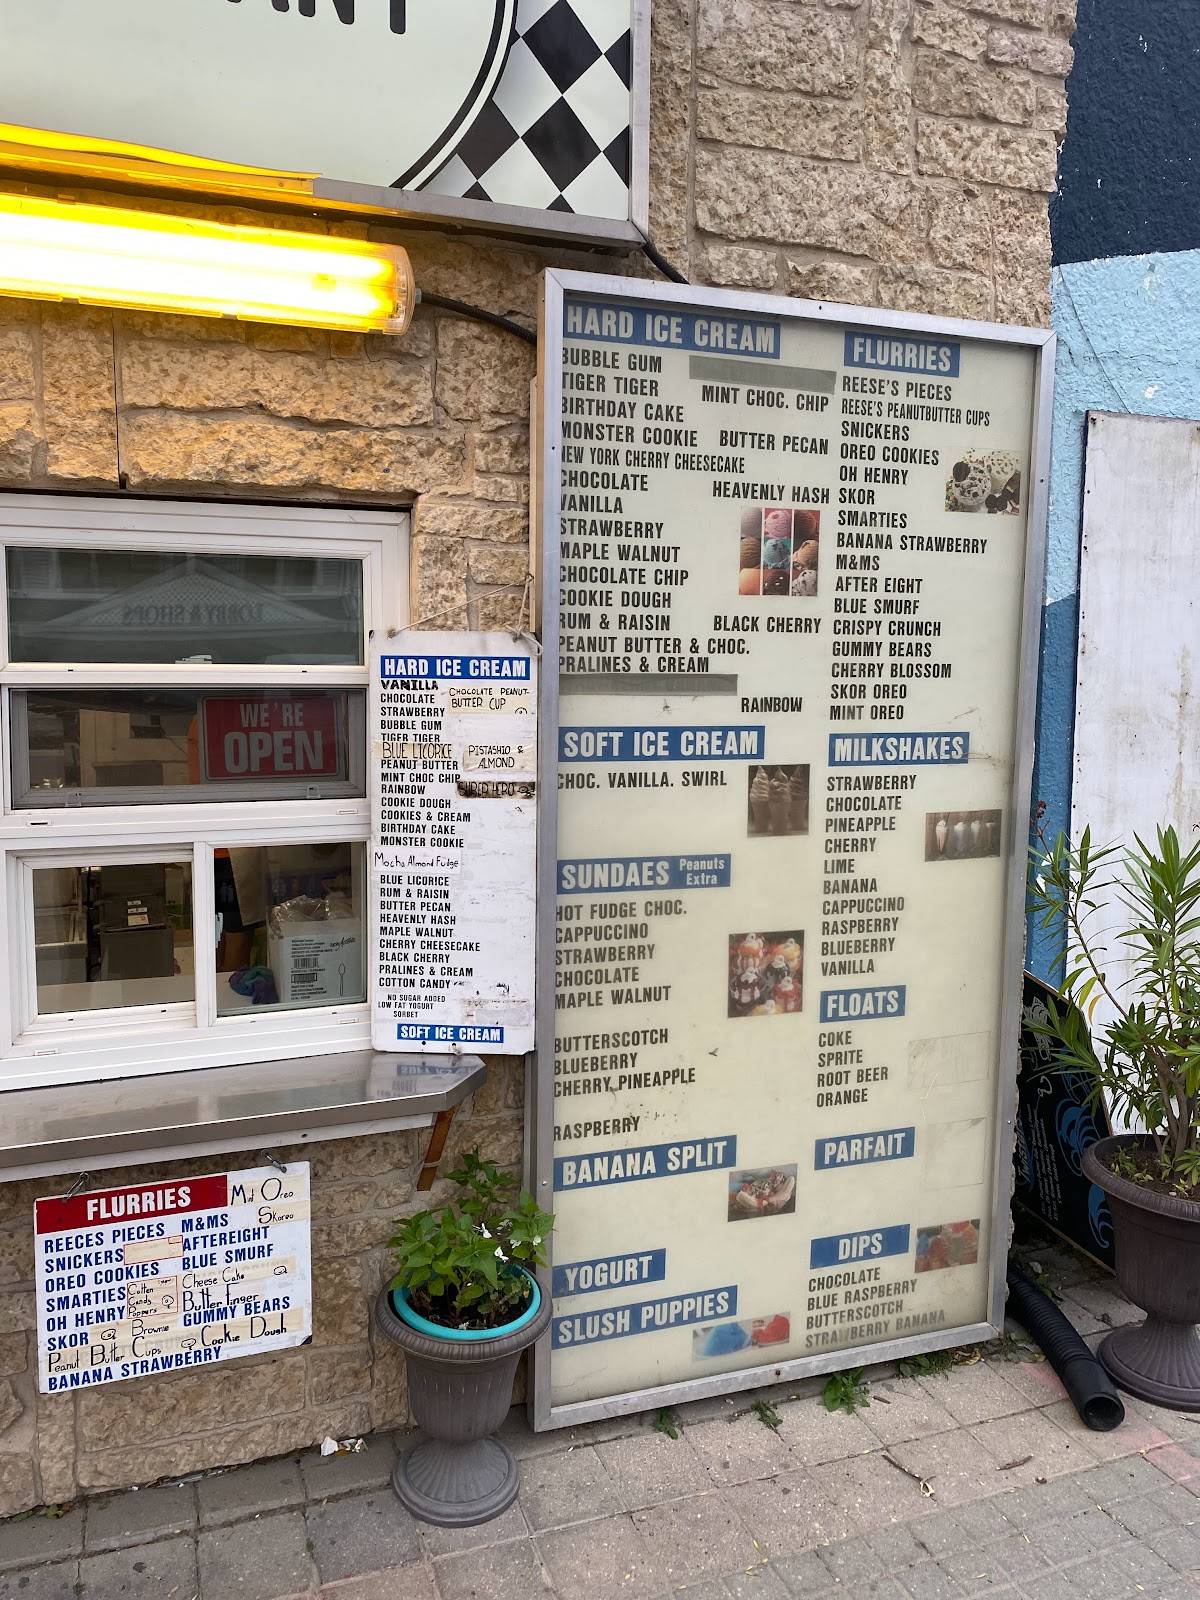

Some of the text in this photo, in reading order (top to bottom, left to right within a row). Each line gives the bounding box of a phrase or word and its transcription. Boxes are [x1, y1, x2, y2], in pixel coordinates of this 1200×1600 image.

[567, 305, 774, 353] HARD ICE CREAM
[628, 353, 662, 373] GUM
[854, 338, 950, 372] FLURRIES
[843, 376, 952, 401] REESE'S PIECES
[701, 385, 829, 412] MINT CHOC. CHIP
[842, 398, 990, 426] REESE'S PEANUTBUTTER CUPS
[643, 427, 698, 447] COOKIE
[841, 421, 909, 441] SNICKERS
[719, 430, 828, 454] BUTTER PECAN
[840, 443, 939, 466] OREO COOKIES
[839, 466, 908, 485] OH HENRY
[713, 481, 830, 504] HEAVENLY HASH
[839, 488, 875, 505] SKOR
[838, 510, 907, 528] SMARTIES
[837, 532, 987, 554] BANANA STRAWBERRY
[836, 554, 880, 571] M&MS
[654, 569, 688, 586] CHIP
[835, 576, 923, 593] AFTER EIGHT
[834, 598, 920, 614] BLUE SMURF
[714, 615, 822, 634] BLACK CHERRY
[833, 620, 941, 636] CRISPY CRUNCH
[625, 637, 681, 653] BUTTER
[690, 638, 700, 653] &
[707, 639, 750, 655] CHOC.
[832, 641, 932, 657] GUMMY BEARS
[385, 659, 525, 676] HARD ICE CREAM
[832, 663, 952, 678] CHERRY BLOSSOM
[381, 680, 438, 690] VANILLA
[741, 697, 802, 712] RAINBOW
[239, 702, 304, 728] WE'RE
[381, 720, 442, 730] BUBBLE GUM
[223, 730, 323, 773] OPEN
[518, 746, 524, 754] &
[564, 731, 758, 757] SOFT ICE CREAM
[835, 737, 963, 761] MILKSHAKES
[381, 773, 461, 783] MINT CHOC CHIP
[827, 775, 917, 791] STRAWBERRY
[382, 785, 425, 794] RAINBOW
[382, 798, 451, 808] COOKIE DOUGH
[826, 796, 902, 812] CHOCOLATE
[381, 823, 455, 834] BIRTHDAY CAKE
[825, 817, 896, 833] PINEAPPLE
[381, 836, 464, 848] MONSTER COOKIE
[680, 858, 724, 871] Peanuts
[824, 859, 855, 874] LIME
[380, 875, 449, 886] BLUE LICORICE
[562, 861, 670, 890] SUNDAES
[686, 874, 717, 885] Extra
[823, 878, 878, 894] BANANA
[380, 901, 450, 912] BUTTER PECAN
[823, 896, 905, 915] CAPPUCCINO
[380, 914, 456, 925] HEAVENLY HASH
[822, 917, 899, 936] RASPBERRY
[380, 926, 454, 937] MAPLE WALNUT
[380, 939, 480, 951] CHERRY CHEESECAKE
[821, 937, 895, 956] BLUEBERRY
[380, 952, 450, 963] BLACK CHERRY
[821, 959, 875, 976] VANILLA
[379, 978, 450, 988] COTTON CANDY
[827, 990, 898, 1018] FLOATS
[401, 1026, 500, 1041] SOFT ICE CREAM
[555, 1028, 668, 1053] BUTTERSCOTCH
[819, 1031, 852, 1047] COKE
[818, 1050, 863, 1068] SPRITE
[817, 1067, 888, 1088] ROOT BEER
[817, 1088, 868, 1107] ORANGE
[824, 1133, 905, 1165] PARFAIT
[563, 1141, 727, 1185] BANANA SPLIT
[87, 1186, 191, 1221] FLURRIES
[182, 1213, 228, 1233] M&MS
[45, 1223, 165, 1253] REECES PIECES
[183, 1226, 270, 1251] AFTEREIGHT
[838, 1233, 883, 1260] DIPS
[45, 1248, 123, 1273] SNICKERS
[182, 1244, 274, 1271] BLUE SMURF
[46, 1262, 159, 1293] OREO COOKIES
[565, 1256, 652, 1291] YOGURT
[809, 1267, 881, 1292] CHOCOLATE
[47, 1286, 126, 1312] SMARTIES
[808, 1279, 918, 1311] BLUE RASPBERRY
[47, 1305, 126, 1331] OH HENRY
[184, 1296, 290, 1327] GUMMY BEARS
[559, 1291, 728, 1344] SLUSH PUPPIES
[47, 1332, 89, 1350] SKOR
[49, 1346, 221, 1391] BANANA STRAWBERRY
